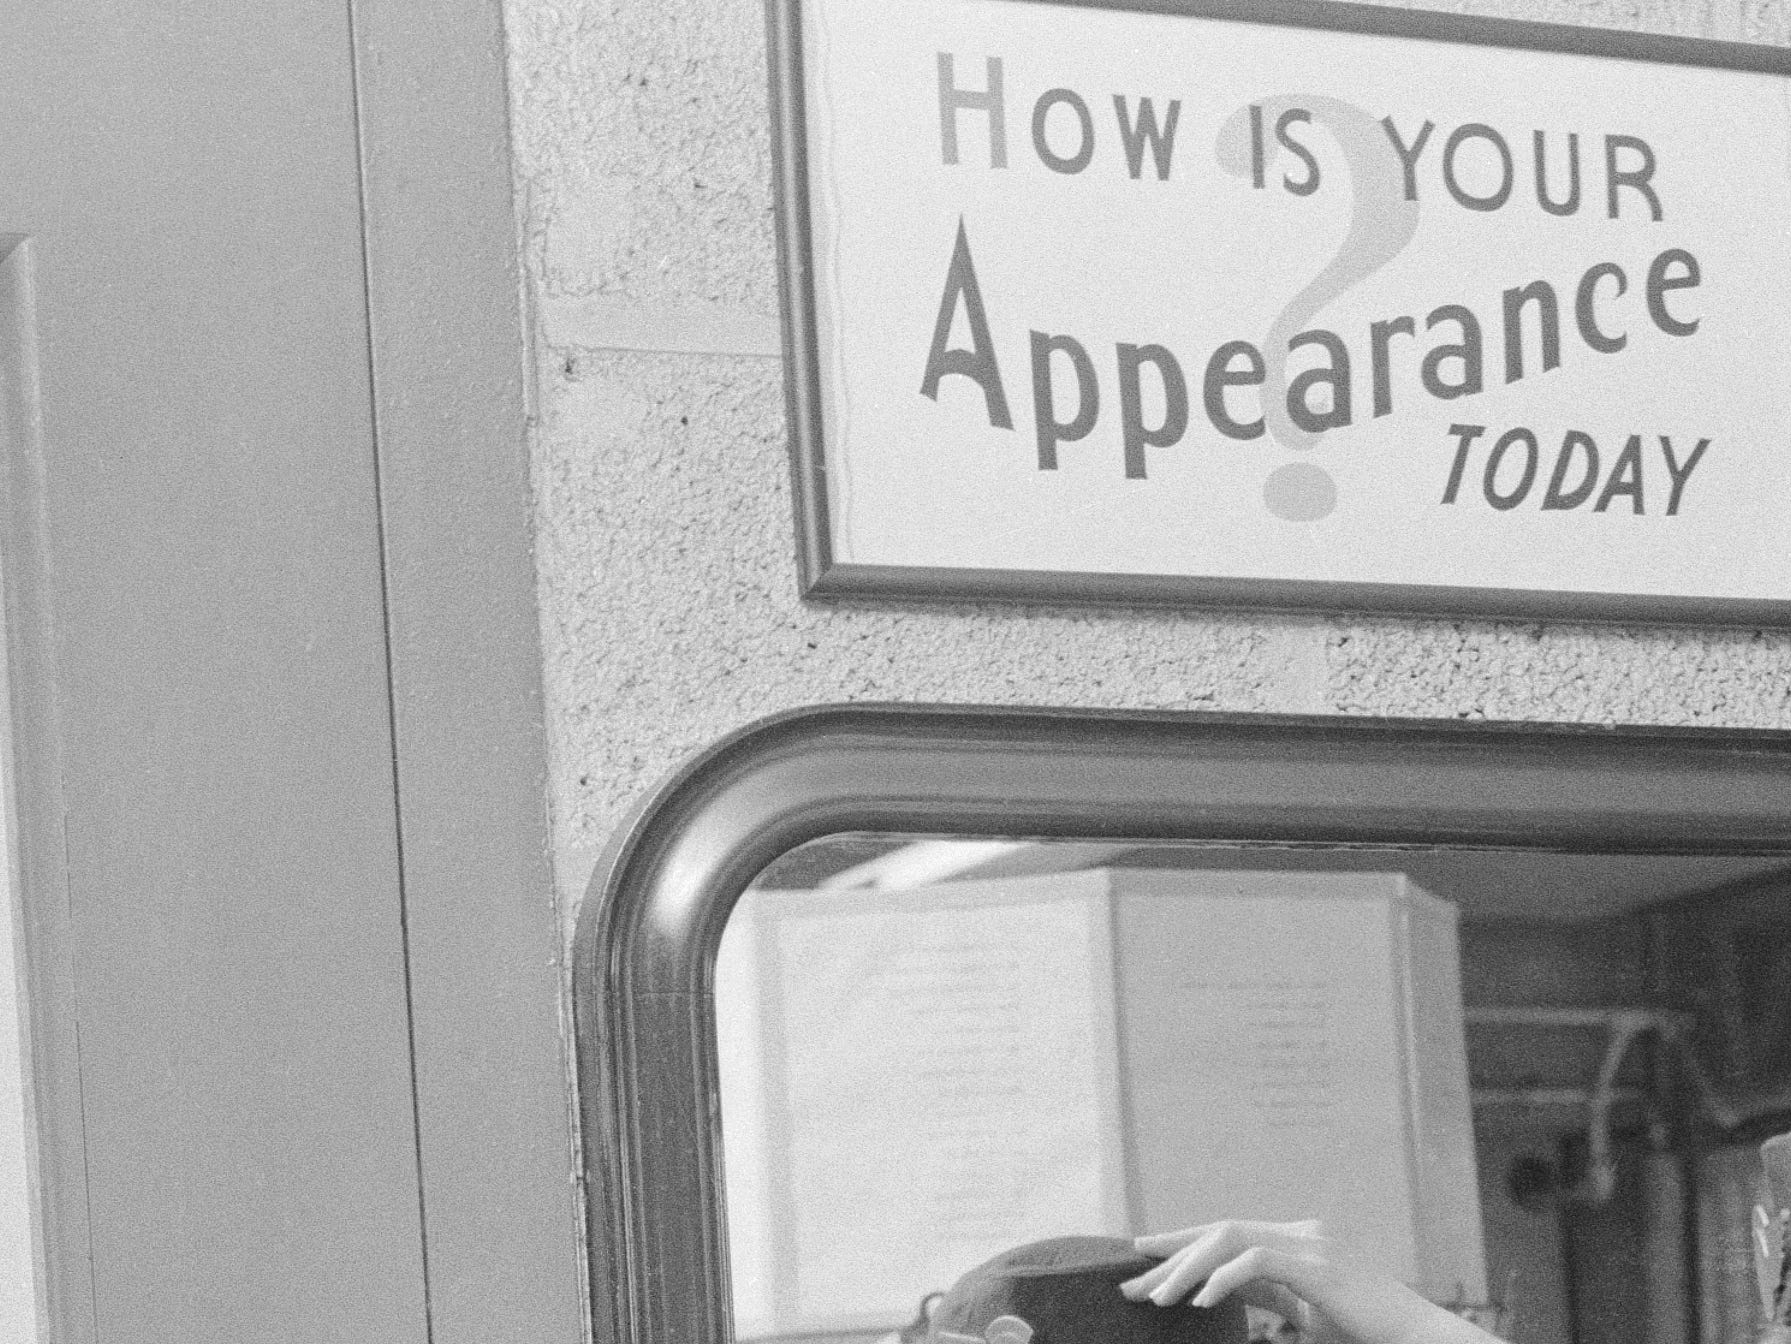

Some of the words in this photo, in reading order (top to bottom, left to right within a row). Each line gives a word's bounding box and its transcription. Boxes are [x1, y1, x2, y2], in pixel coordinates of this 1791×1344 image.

[936, 51, 1182, 182] HOW
[1248, 104, 1321, 196] IS
[1378, 117, 1664, 223] YOUR
[919, 213, 1702, 480] Appearance
[1440, 423, 1711, 518] TODAY
